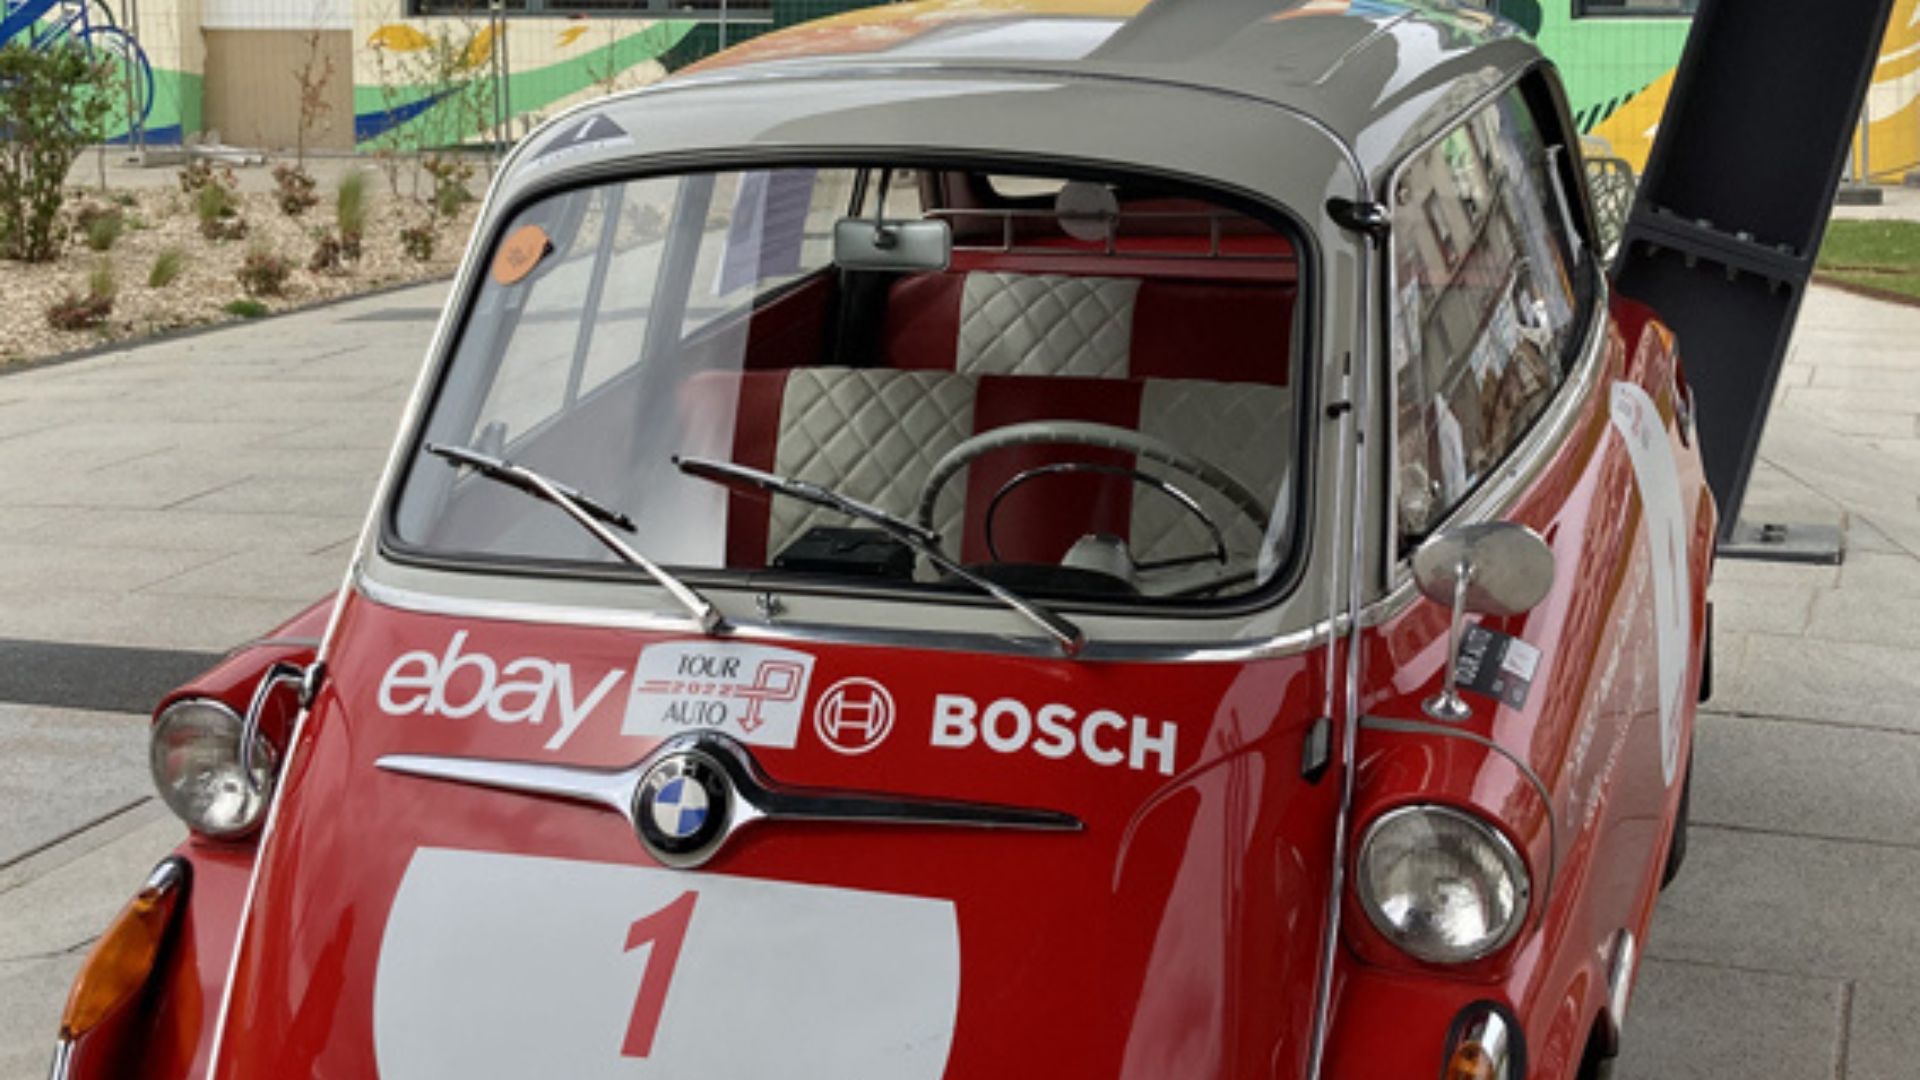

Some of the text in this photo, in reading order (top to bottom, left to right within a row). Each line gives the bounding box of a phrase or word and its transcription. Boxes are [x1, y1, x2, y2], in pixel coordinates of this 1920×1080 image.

[377, 630, 626, 750] ebay
[671, 681, 733, 696] 2022
[677, 654, 741, 678] TOUR
[661, 701, 727, 725] AUTO
[930, 693, 1178, 776] BOSCH
[620, 890, 699, 1058] 1
